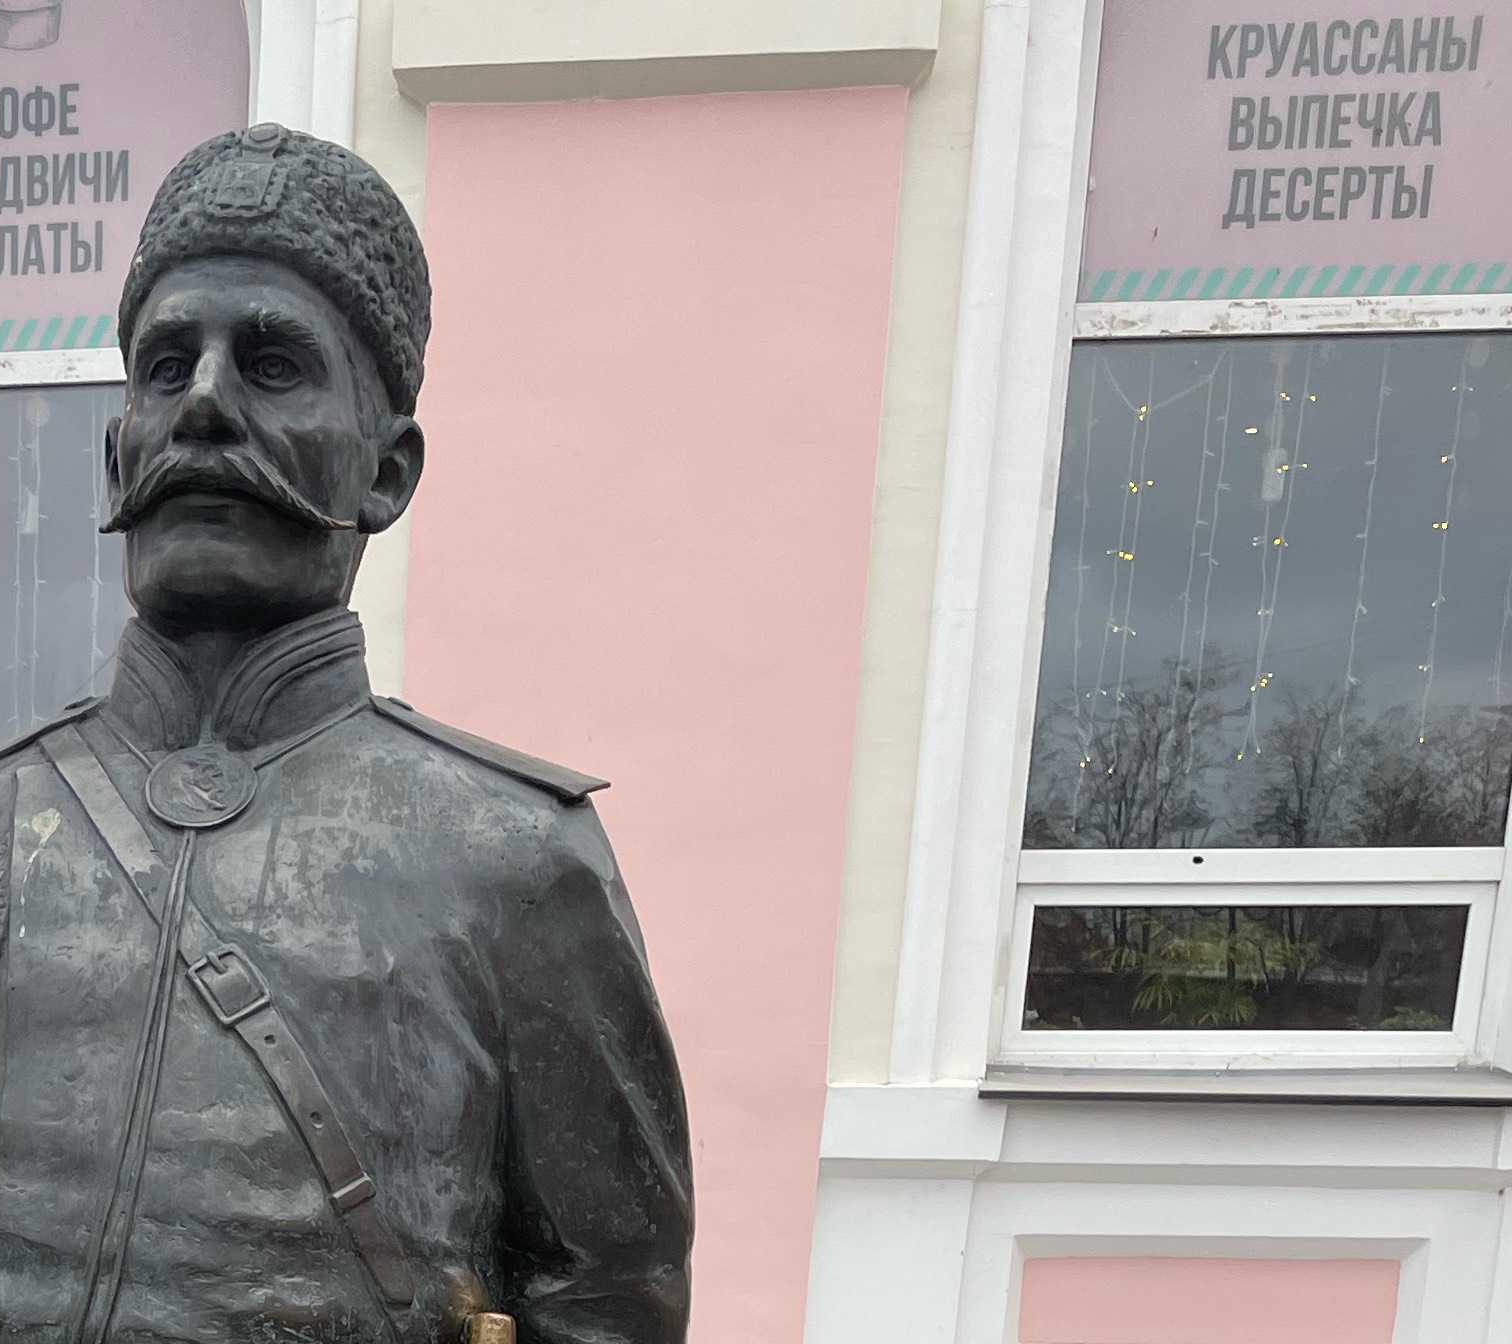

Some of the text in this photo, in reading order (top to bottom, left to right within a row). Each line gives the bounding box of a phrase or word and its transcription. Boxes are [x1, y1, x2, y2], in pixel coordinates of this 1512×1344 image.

[1206, 14, 1485, 80] КРУАССАНЫ
[1227, 90, 1442, 152] ВЫПЕЧКА
[1221, 164, 1434, 230] ДЕСЕРТЫ
